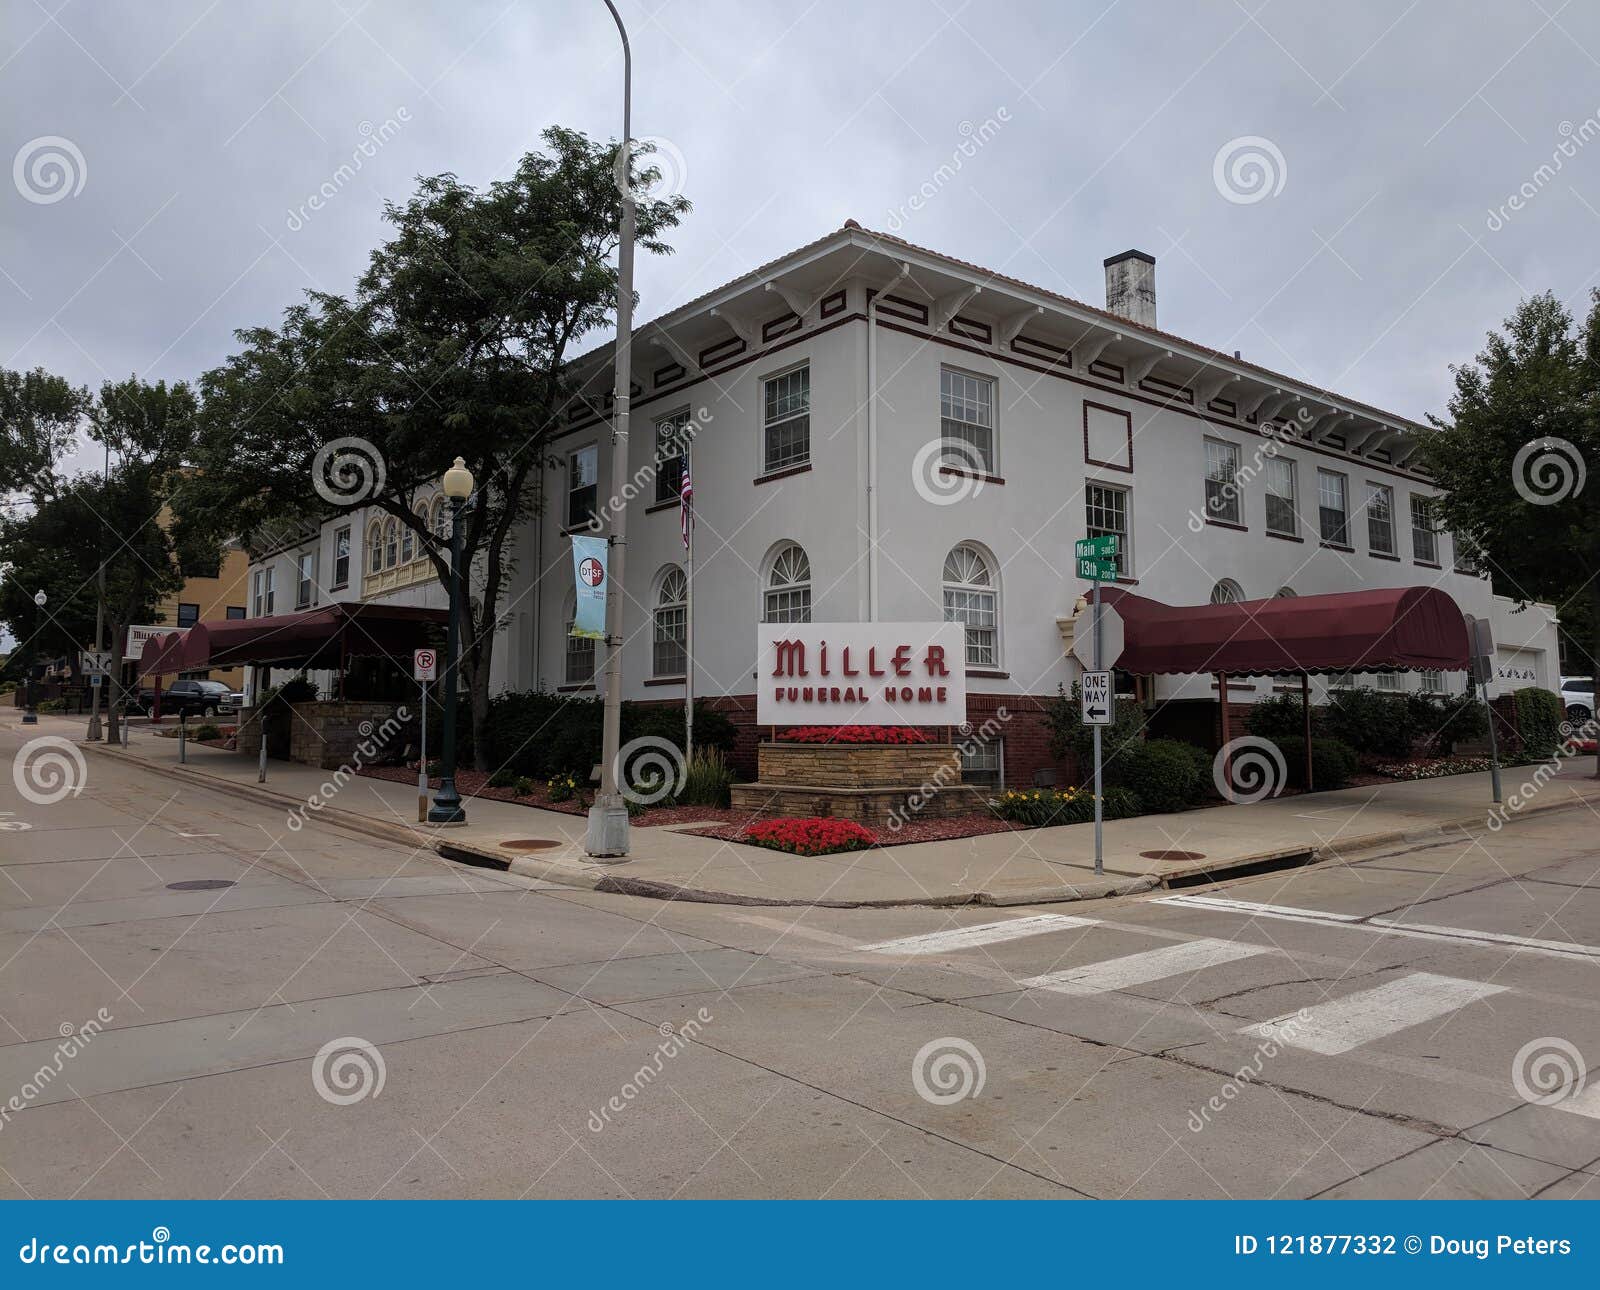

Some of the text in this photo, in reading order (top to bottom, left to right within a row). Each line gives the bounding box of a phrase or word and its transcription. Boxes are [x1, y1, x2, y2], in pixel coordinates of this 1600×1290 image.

[1076, 542, 1095, 558] Main
[582, 567, 602, 578] DTSF
[1081, 560, 1097, 577] 13th
[1084, 675, 1107, 688] ONE
[775, 686, 947, 703] FUNERAL HOME
[1084, 690, 1107, 703] WAY
